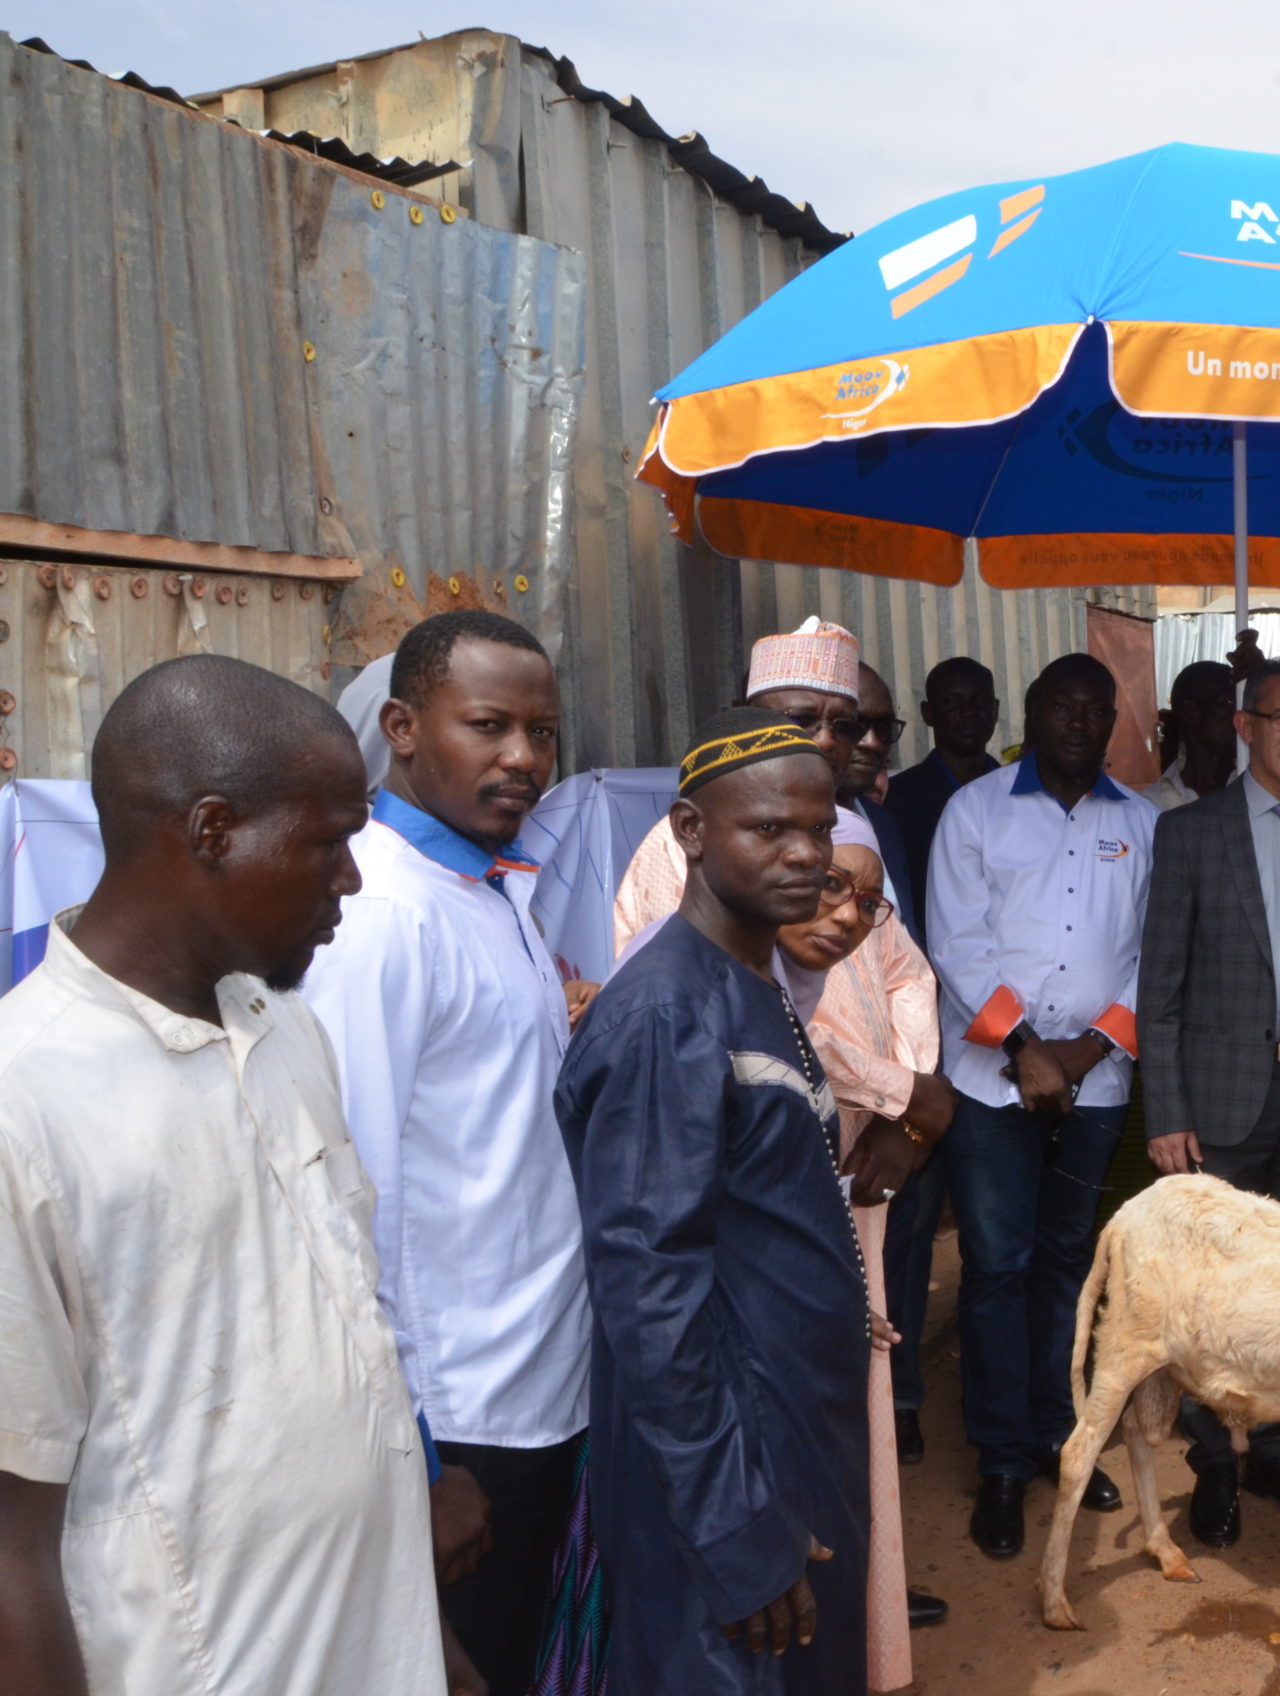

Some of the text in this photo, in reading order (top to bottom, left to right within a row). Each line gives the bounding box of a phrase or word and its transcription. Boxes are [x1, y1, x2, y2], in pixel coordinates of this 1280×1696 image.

[1186, 349, 1222, 377] Un
[838, 369, 884, 385] Moov
[835, 384, 880, 401] Africa
[842, 418, 867, 431] Niger
